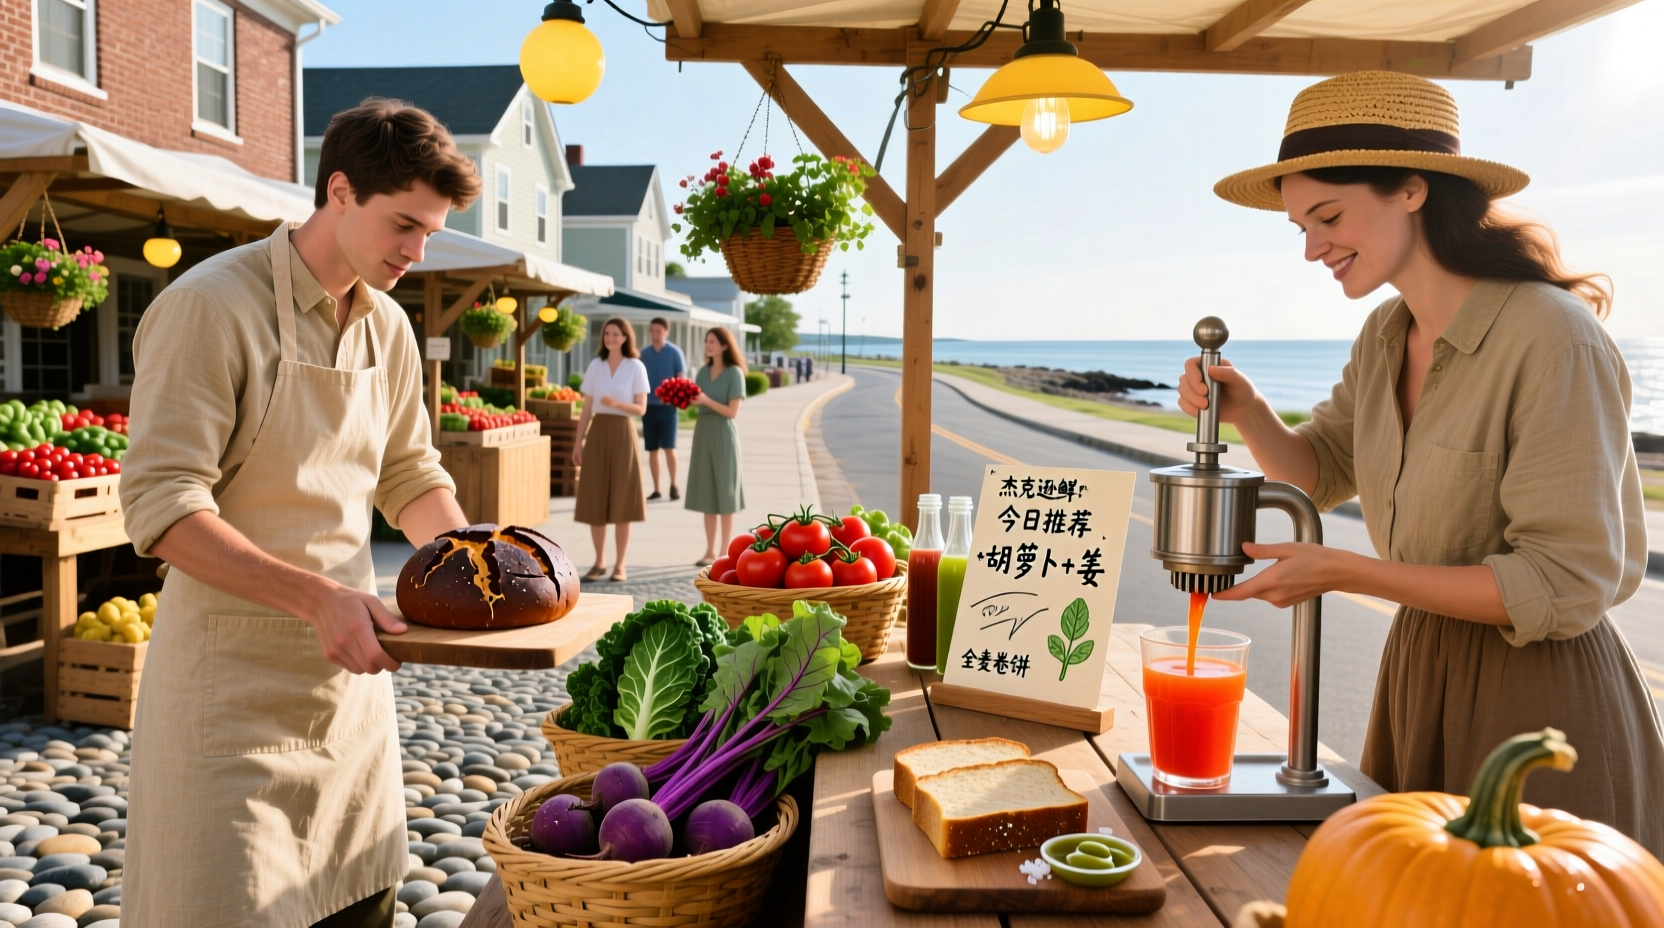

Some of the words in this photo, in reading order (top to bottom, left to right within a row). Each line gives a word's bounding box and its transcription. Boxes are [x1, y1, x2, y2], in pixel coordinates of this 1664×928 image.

[998, 504, 1092, 538] 今日推荐
[961, 648, 1030, 678] 全麦卷饼
